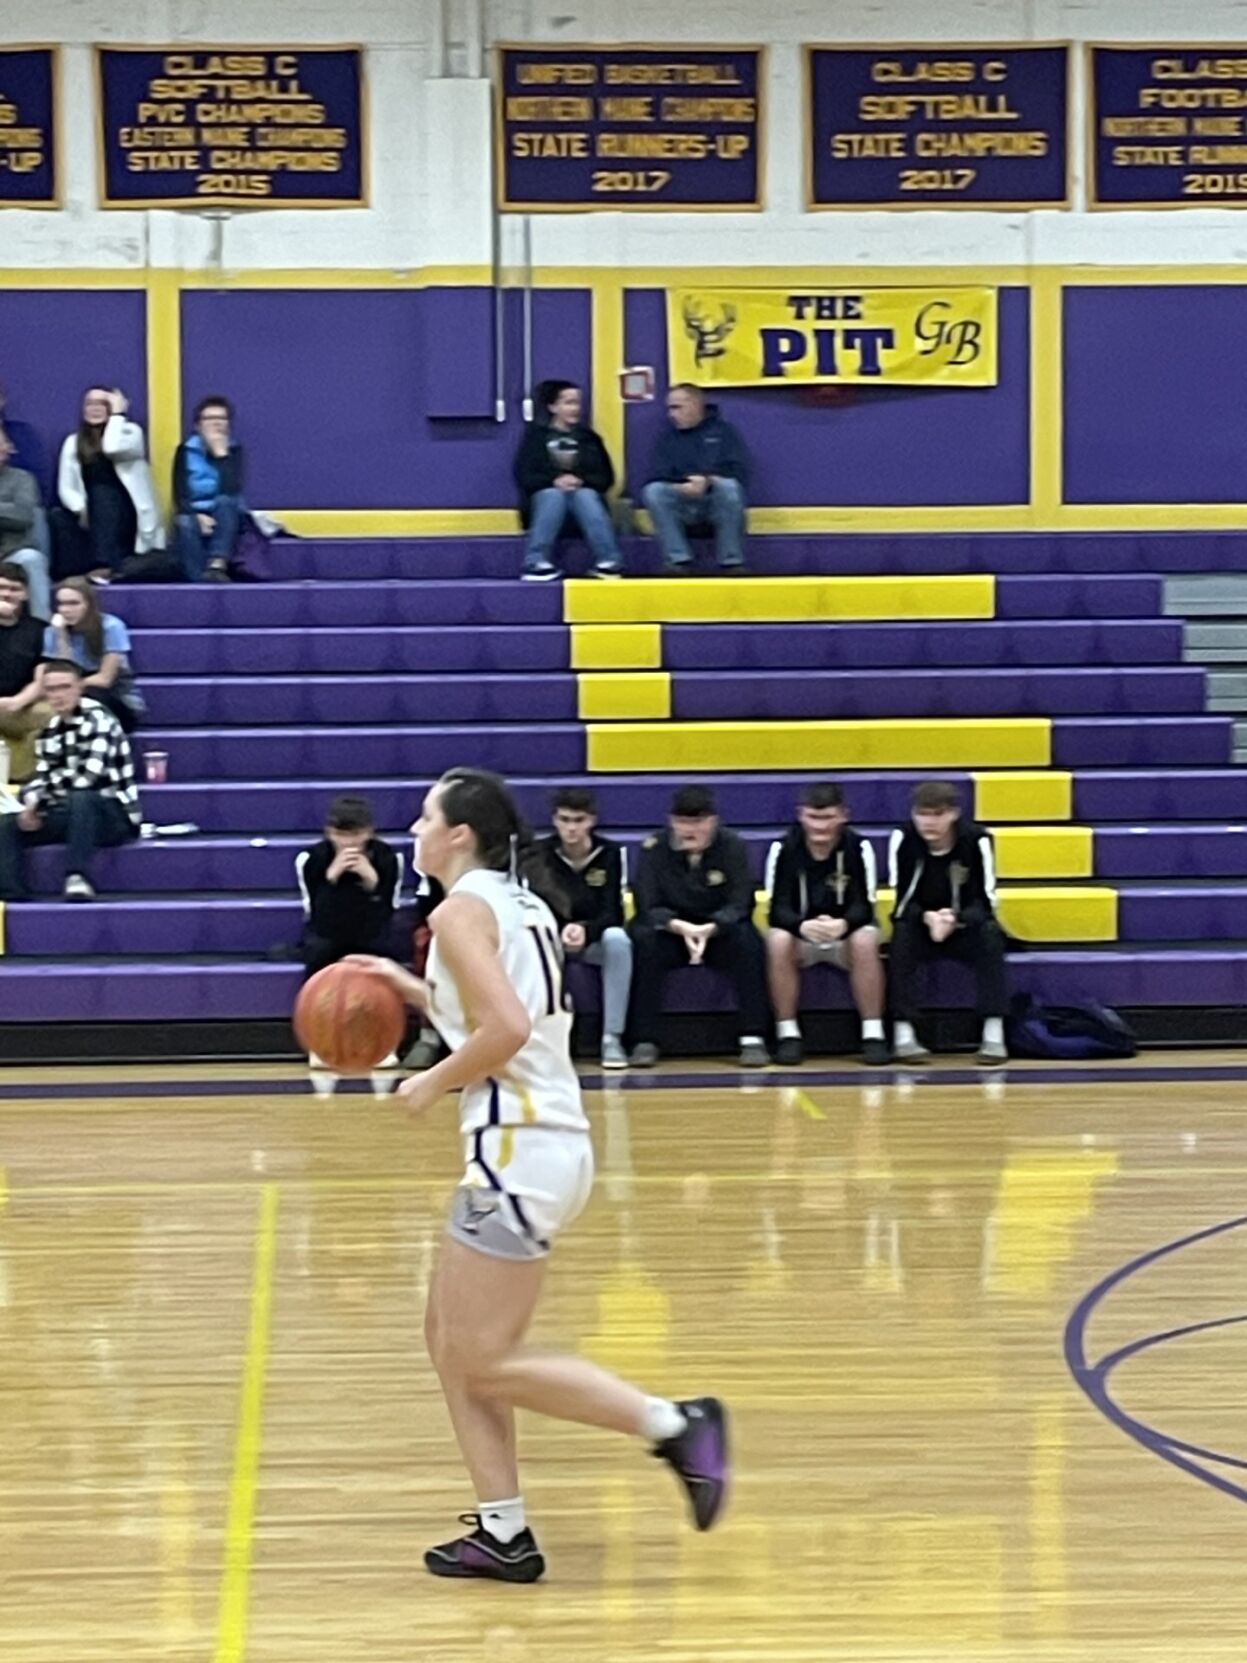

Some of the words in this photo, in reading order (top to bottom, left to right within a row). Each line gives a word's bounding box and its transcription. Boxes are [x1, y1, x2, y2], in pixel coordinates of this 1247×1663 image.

[165, 56, 266, 75] CLASS
[275, 56, 297, 75] C
[874, 62, 975, 82] CLASS
[983, 62, 1007, 81] C
[1152, 60, 1247, 79] CLASS
[151, 79, 312, 99] SOFTBALL
[138, 103, 186, 123] PVC
[196, 104, 325, 123] CHAMPIONS
[859, 95, 1020, 120] SOFTBALL
[513, 133, 589, 157] STATE
[597, 134, 748, 158] RUNNERS-UP
[832, 133, 907, 158] STATE
[915, 132, 1048, 156] CHAMPIONS
[127, 151, 200, 171] STATE
[210, 151, 340, 171] CHAMPIONS
[1113, 146, 1184, 165] STATE
[196, 174, 271, 195] 2015
[592, 171, 671, 191] 2017
[898, 169, 976, 190] 2017
[787, 295, 864, 320] THE
[760, 327, 894, 378] PIT
